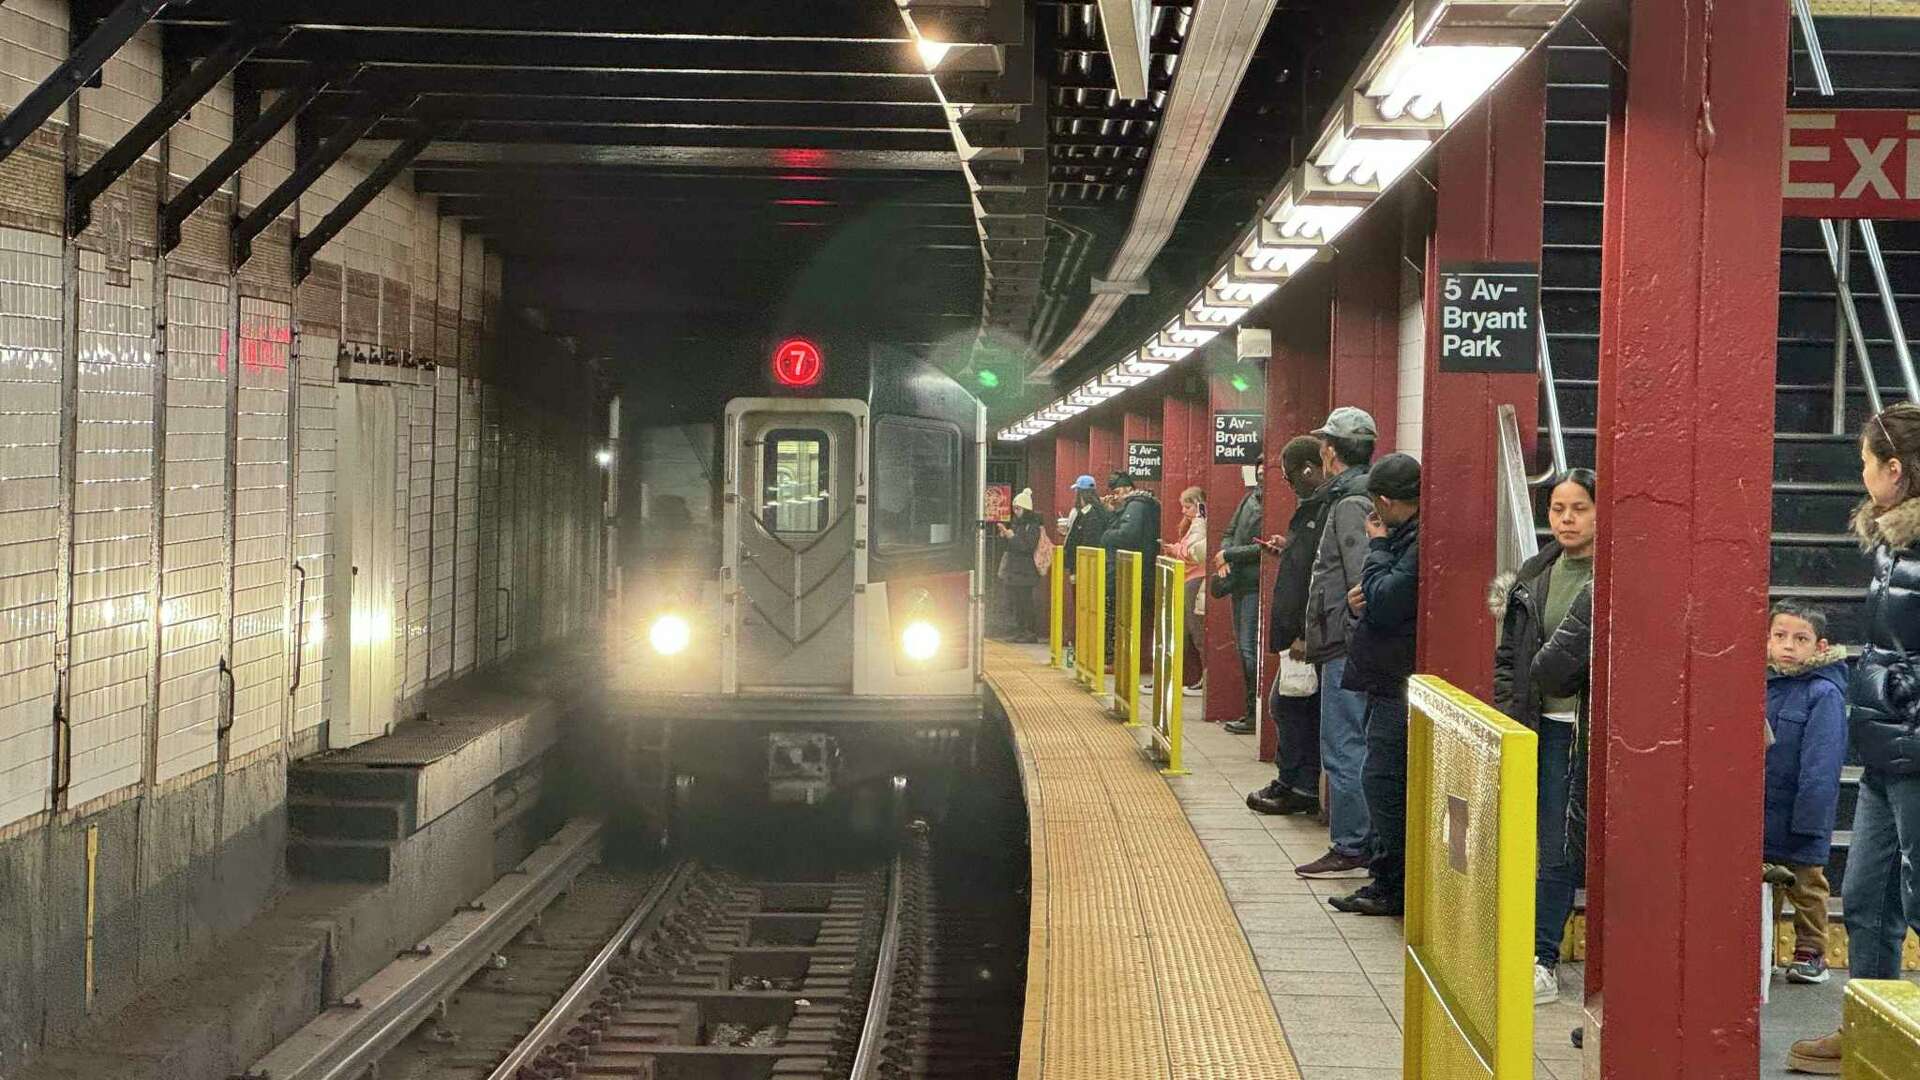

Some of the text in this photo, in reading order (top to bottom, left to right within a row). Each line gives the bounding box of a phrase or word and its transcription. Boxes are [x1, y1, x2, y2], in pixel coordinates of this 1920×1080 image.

[1444, 278, 1518, 300] 5 Av-
[1444, 306, 1527, 333] Bryant
[1443, 335, 1501, 357] Park
[791, 350, 805, 375] 7
[1216, 416, 1252, 429] 5 Av-
[1215, 431, 1257, 445] Bryant
[1129, 445, 1158, 455] 5 Av-
[1215, 445, 1245, 457] Park
[1129, 456, 1160, 467] Bryant
[1129, 466, 1151, 476] Park
